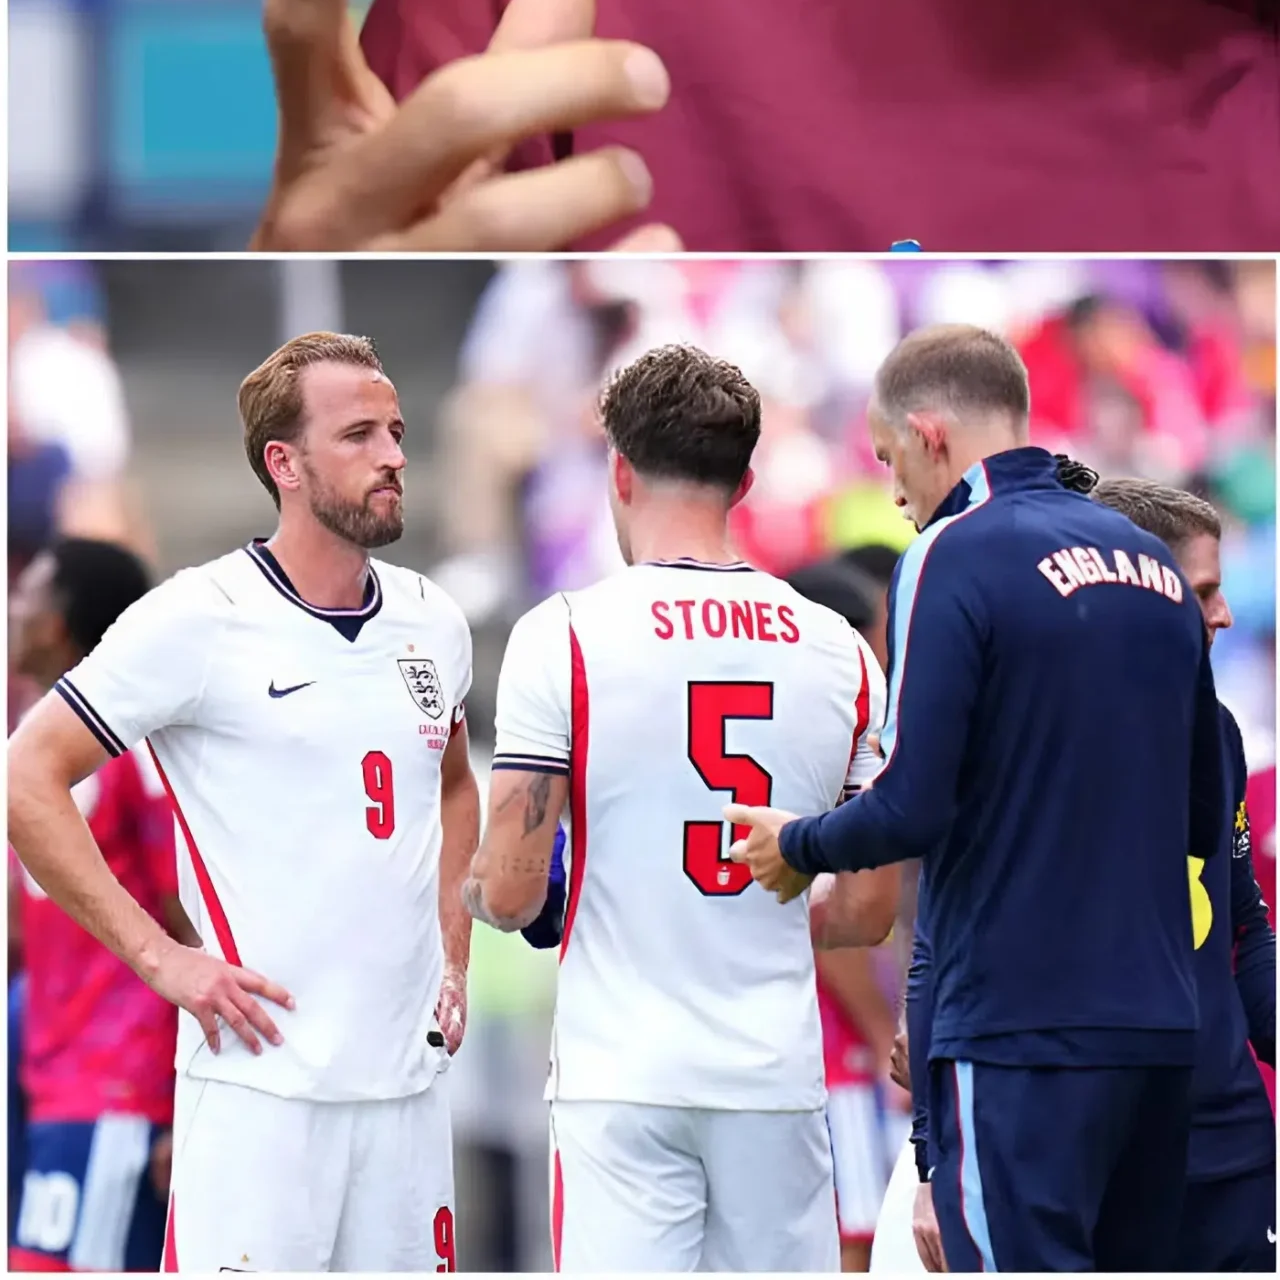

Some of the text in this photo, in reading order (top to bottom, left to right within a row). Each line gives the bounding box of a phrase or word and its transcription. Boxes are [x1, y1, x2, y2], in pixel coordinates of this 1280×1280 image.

[1036, 546, 1184, 604] ENGLAND
[651, 598, 800, 644] STONES
[361, 750, 395, 840] 9
[683, 681, 774, 896] 5
[433, 1206, 456, 1273] 9
